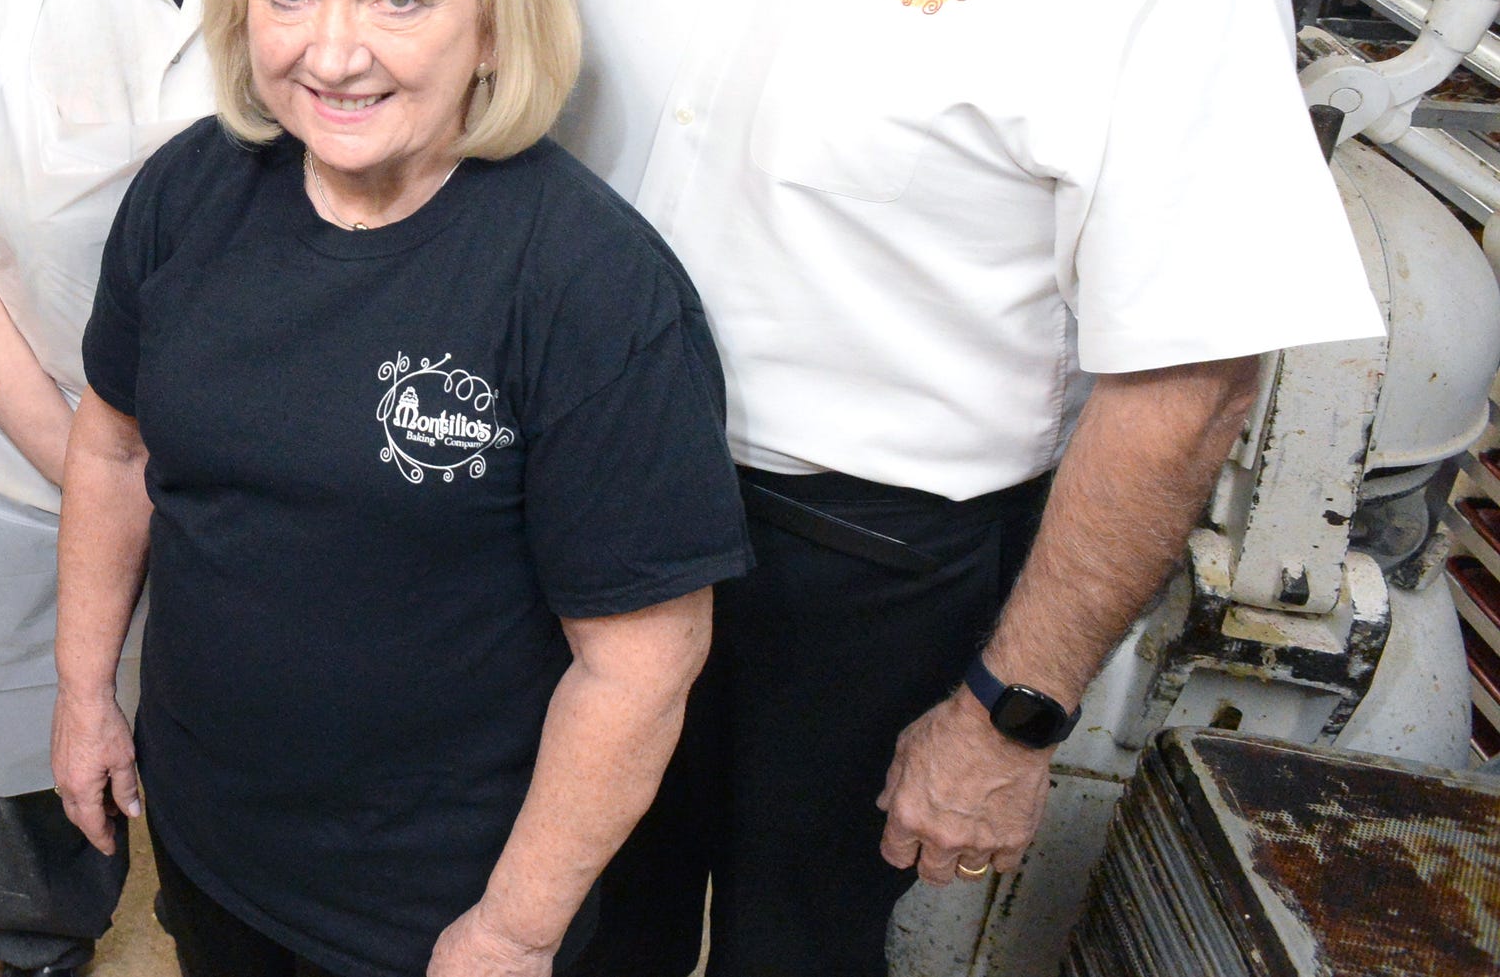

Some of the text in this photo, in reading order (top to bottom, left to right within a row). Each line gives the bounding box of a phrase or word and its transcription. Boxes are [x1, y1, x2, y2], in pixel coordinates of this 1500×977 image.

[393, 403, 492, 442] Montilio's
[406, 430, 483, 450] Baking Company
